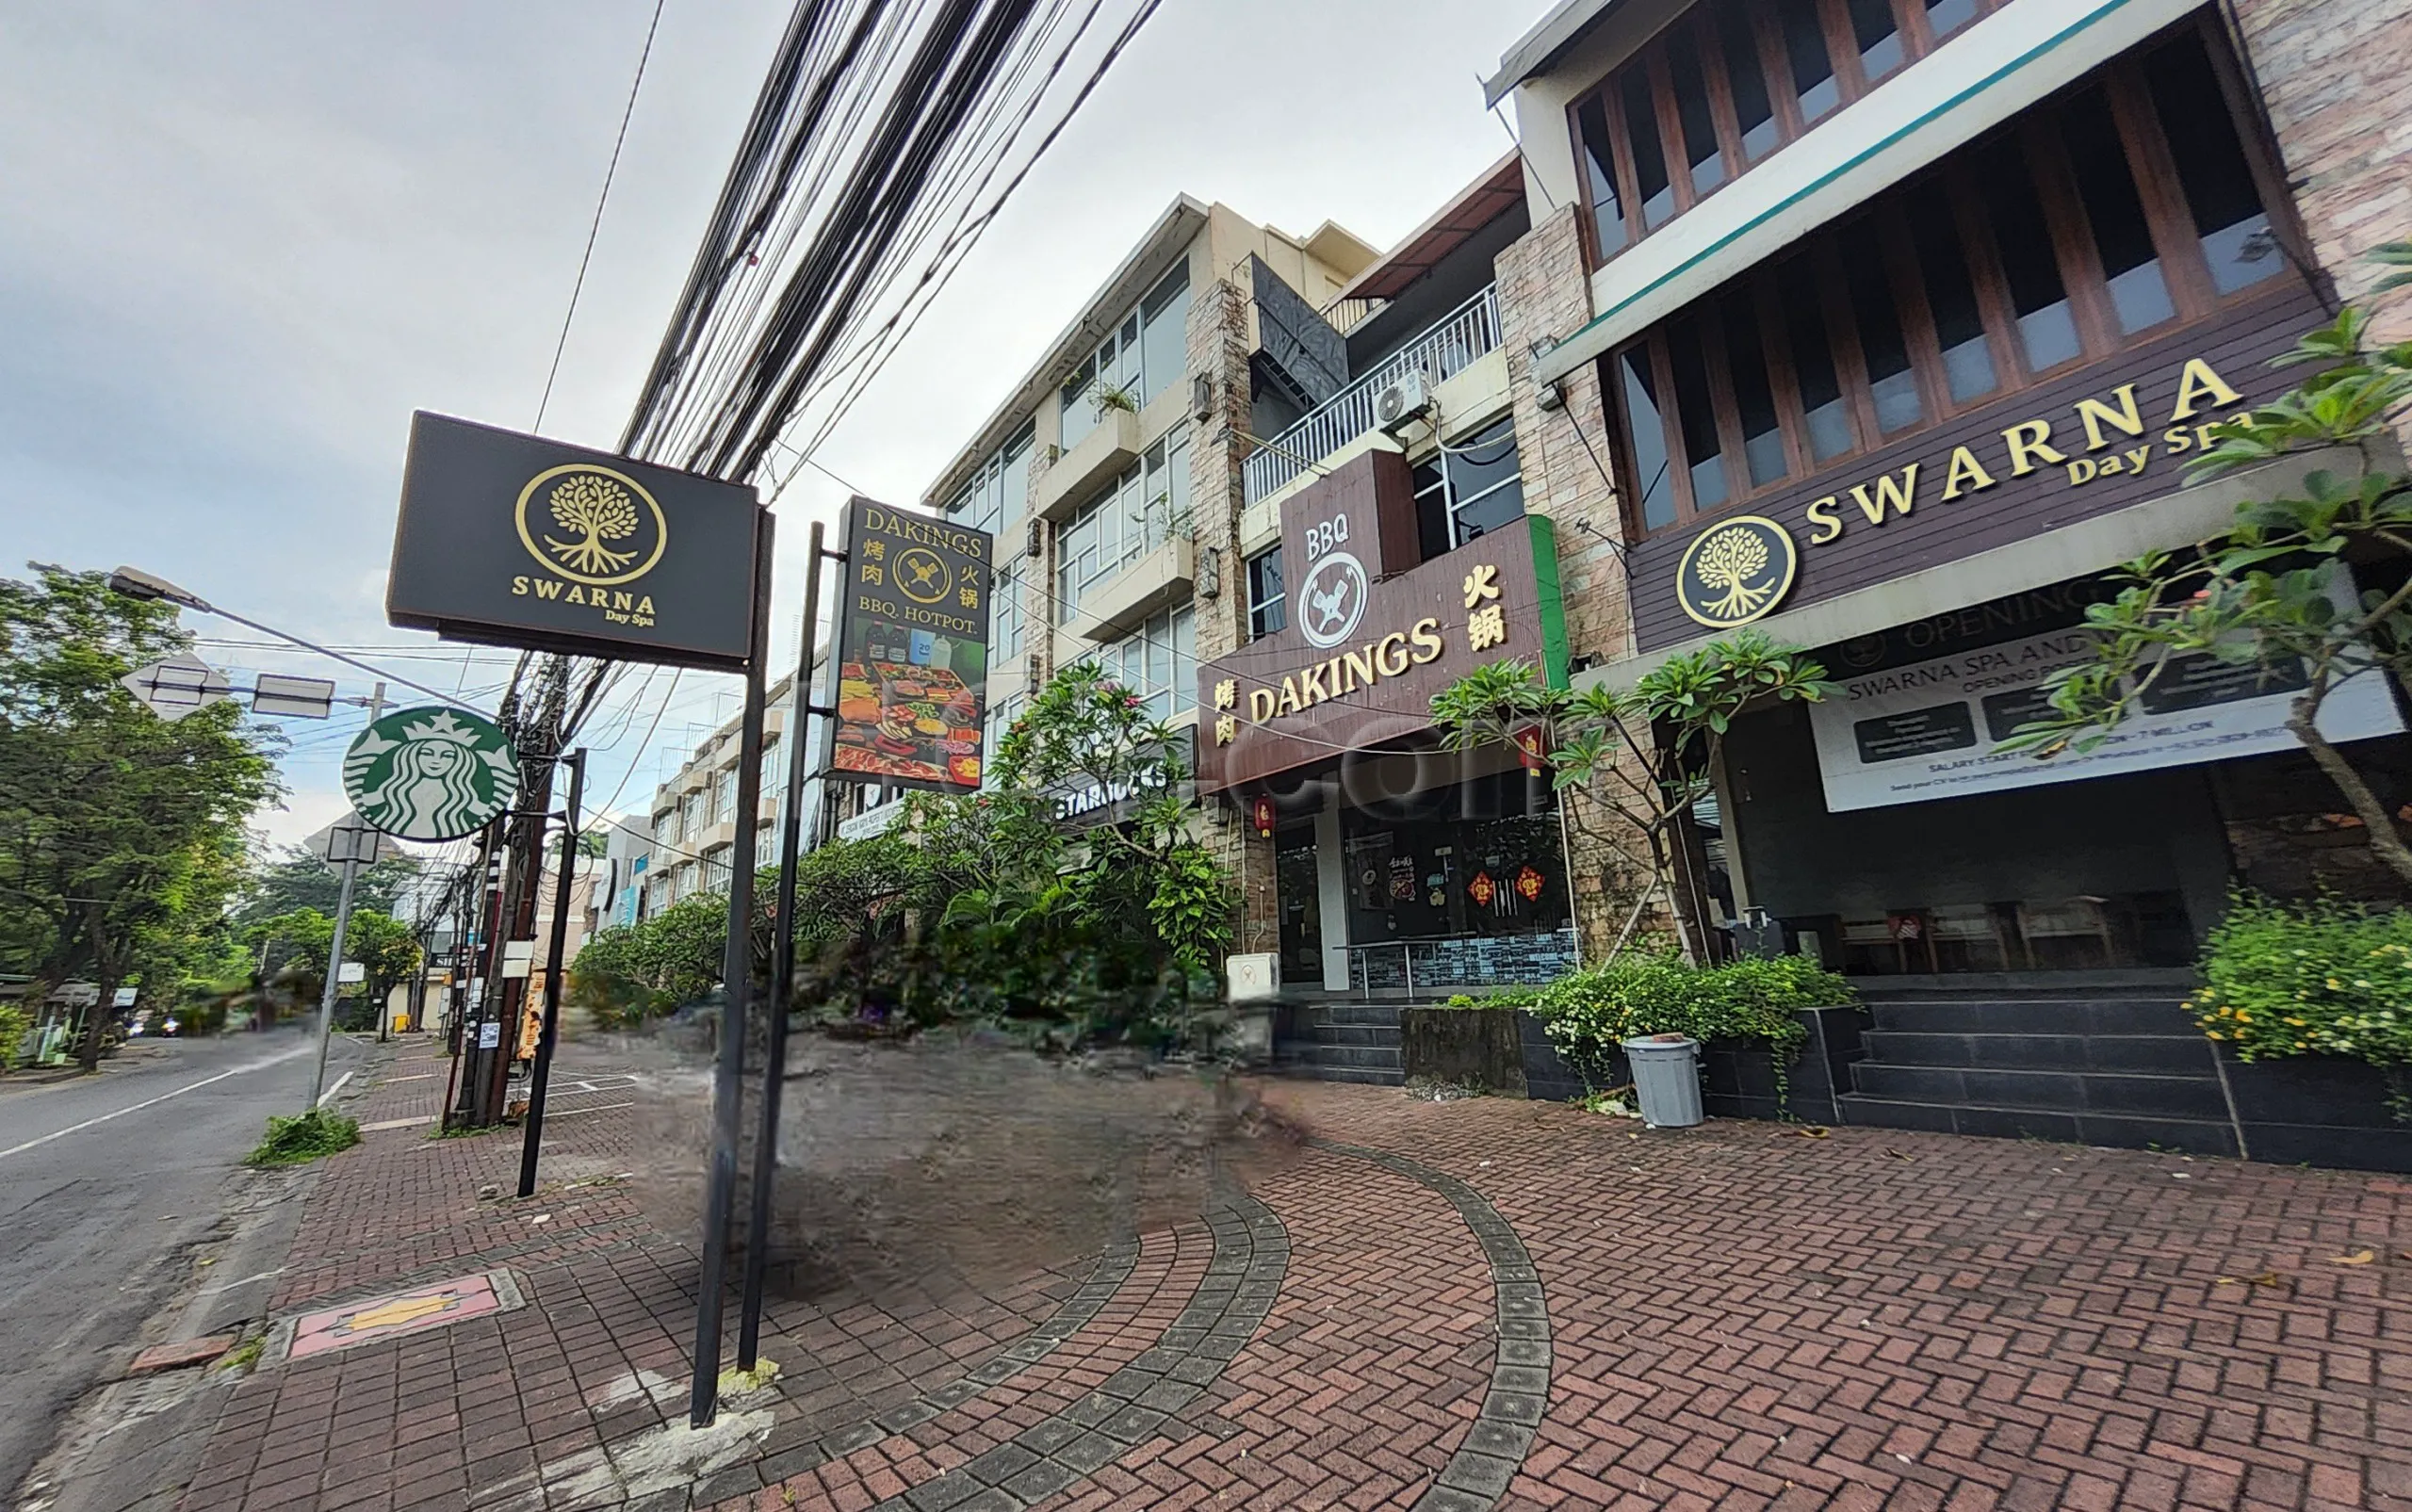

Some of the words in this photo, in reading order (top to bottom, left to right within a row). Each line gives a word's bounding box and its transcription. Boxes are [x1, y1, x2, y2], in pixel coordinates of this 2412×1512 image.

[1806, 357, 2244, 545] SWARNA
[2066, 444, 2152, 487] Day
[864, 508, 983, 560] DAKINGS
[1306, 512, 1349, 562] BBQ
[861, 538, 886, 586] 烤肉
[958, 564, 980, 610] 火锅
[512, 576, 656, 615] SWARNA
[605, 610, 630, 625] Day
[631, 613, 655, 627] Spa
[1463, 564, 1506, 653] 火锅
[1249, 617, 1442, 725] DAKINGS
[1849, 663, 1960, 703] SWARNA
[1965, 650, 2007, 677] SPA
[2019, 634, 2088, 663] AND
[1962, 668, 2036, 694] OPENING
[1214, 678, 1237, 747] 烤肉
